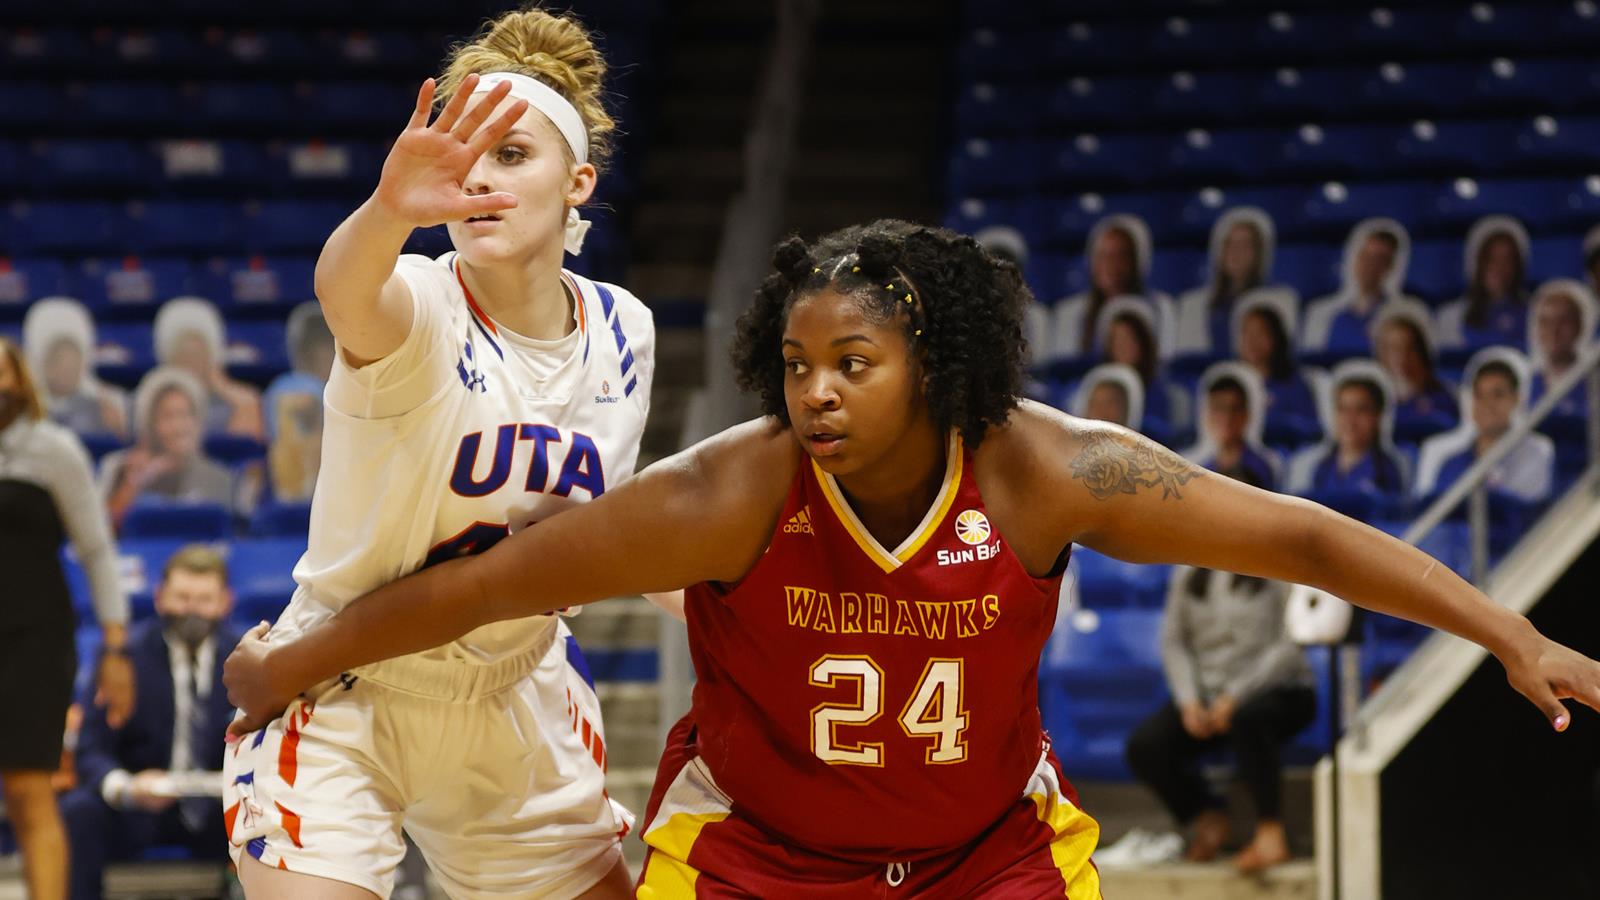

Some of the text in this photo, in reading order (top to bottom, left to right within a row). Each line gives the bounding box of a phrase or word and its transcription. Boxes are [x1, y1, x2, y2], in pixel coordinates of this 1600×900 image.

[449, 423, 605, 500] UTA
[784, 586, 1000, 640] WARHAWKS
[808, 653, 970, 768] 24
